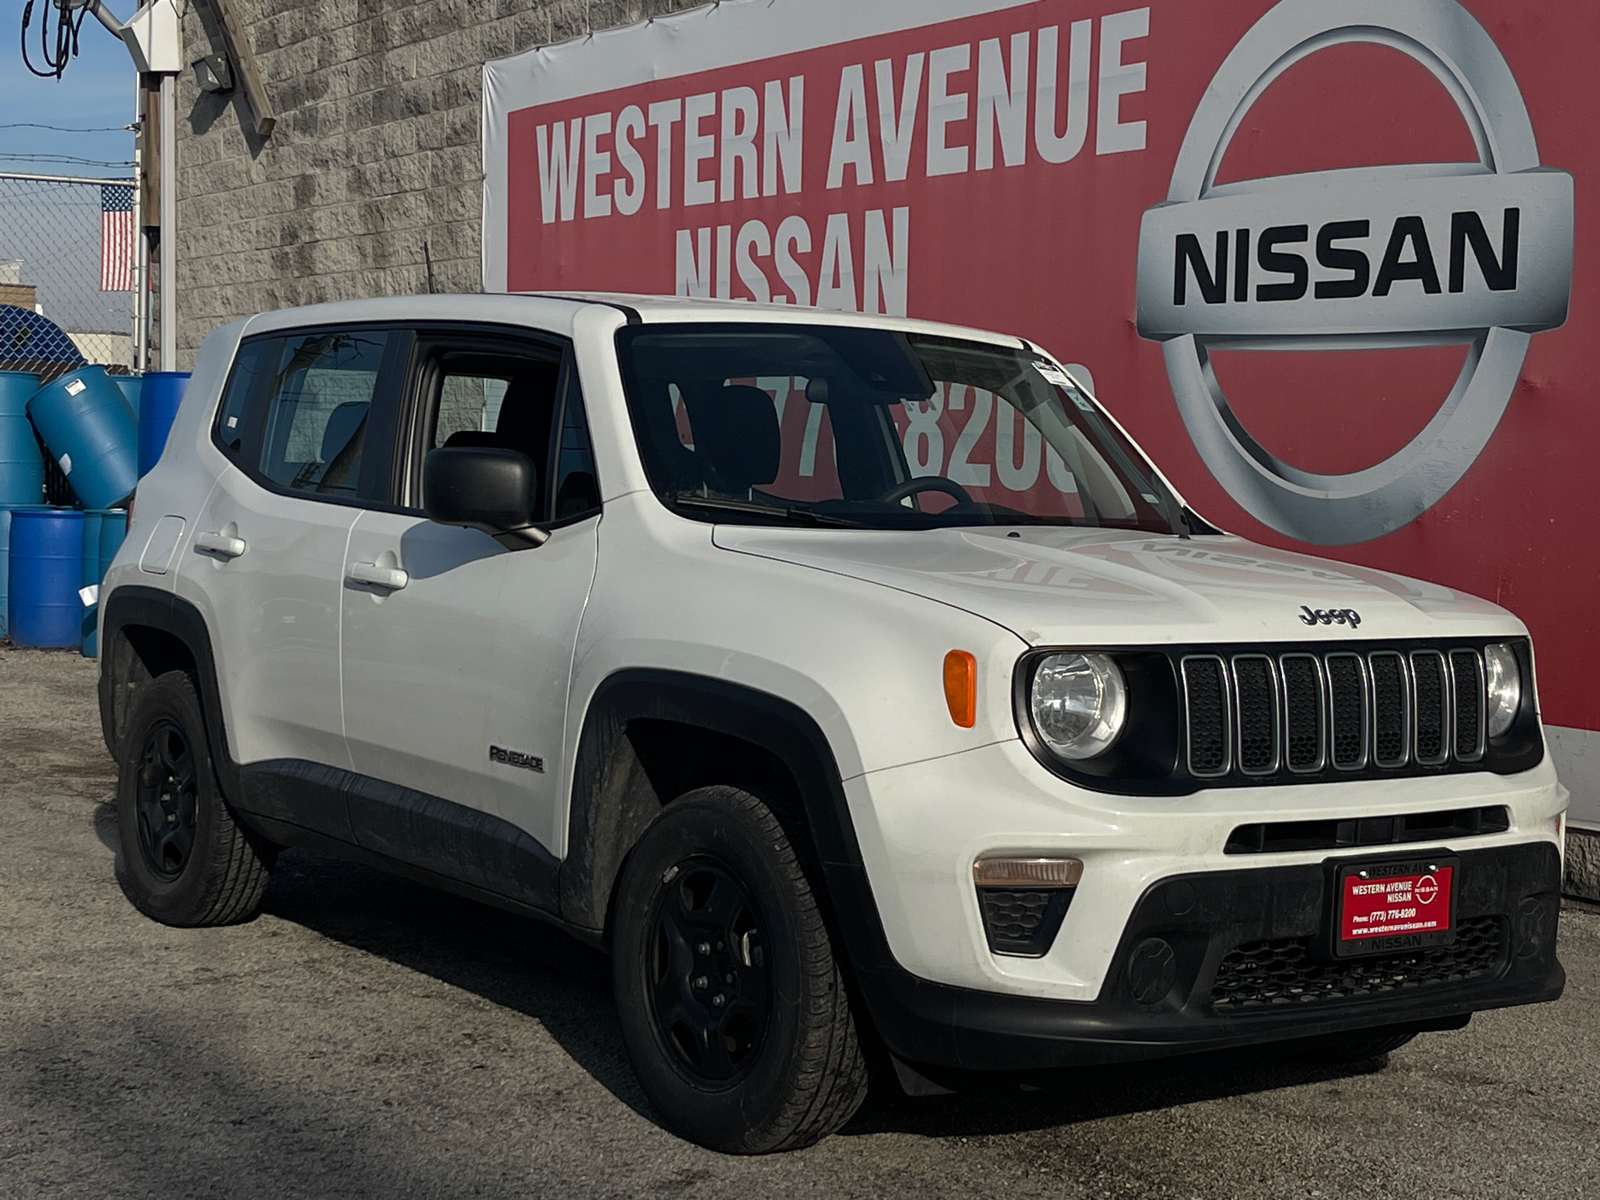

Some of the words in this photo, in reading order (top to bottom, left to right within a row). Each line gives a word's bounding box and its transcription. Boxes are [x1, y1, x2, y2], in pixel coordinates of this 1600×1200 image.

[535, 75, 805, 225] WESTERN
[826, 6, 1151, 190] AVENUE
[675, 205, 910, 319] NISSAN
[1172, 207, 1520, 306] NISSAN
[1298, 605, 1362, 629] Jeep
[489, 744, 545, 774] RENEGADE
[1369, 863, 1410, 878] WESTERN
[1352, 883, 1386, 896] WESTERN
[1386, 881, 1412, 893] AVENUE
[1387, 892, 1412, 904] NISSAN
[1369, 910, 1386, 924] (773)
[1387, 907, 1417, 920] 776-8200
[1371, 935, 1422, 950] NISSAN
